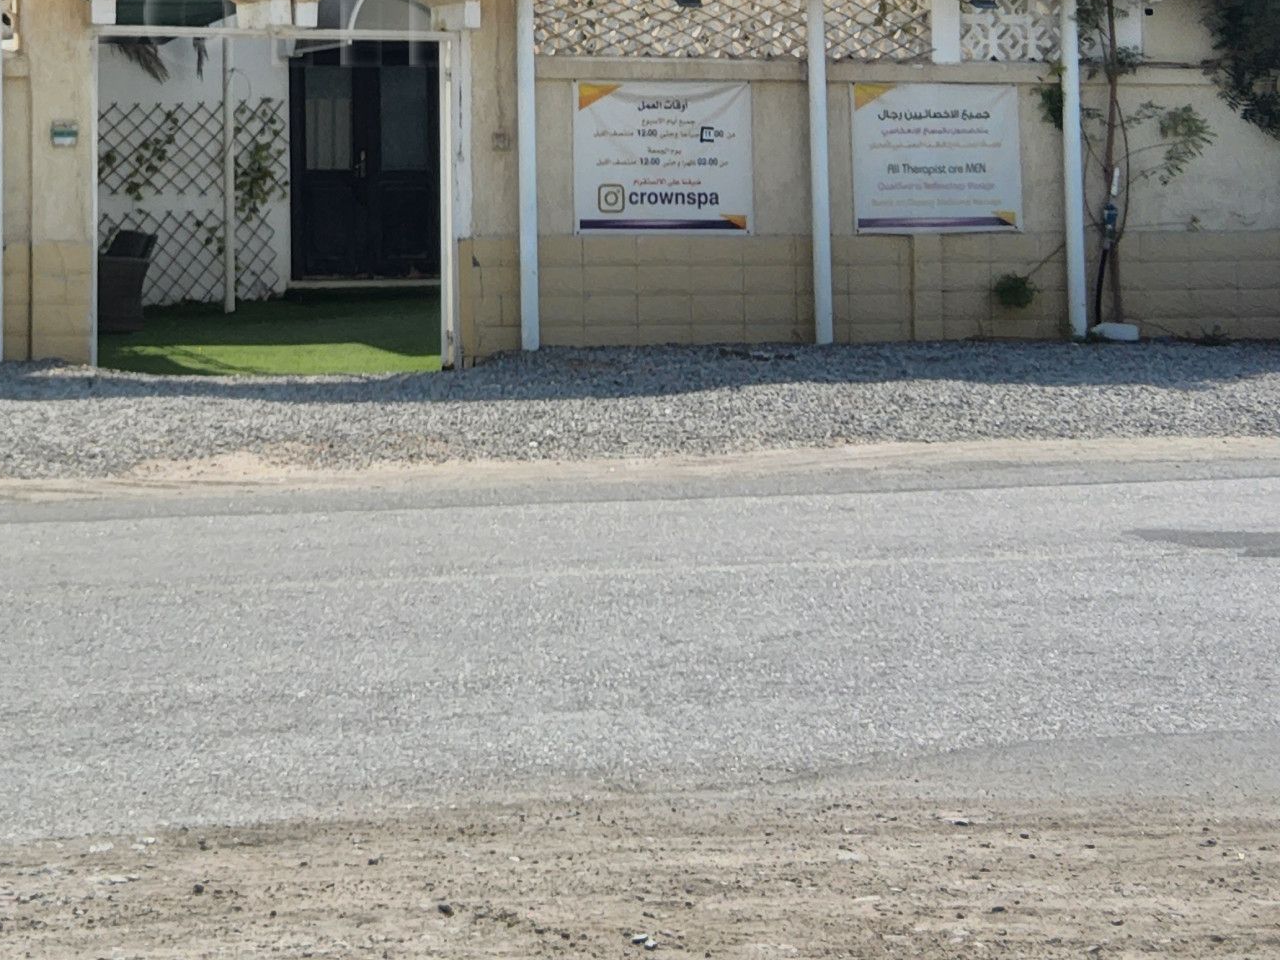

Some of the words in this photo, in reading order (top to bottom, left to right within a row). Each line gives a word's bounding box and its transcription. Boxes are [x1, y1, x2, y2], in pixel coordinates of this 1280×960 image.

[878, 109, 903, 121] رجال
[960, 108, 991, 121] جميع
[965, 162, 987, 174] MEN
[628, 190, 720, 210] crownspa
